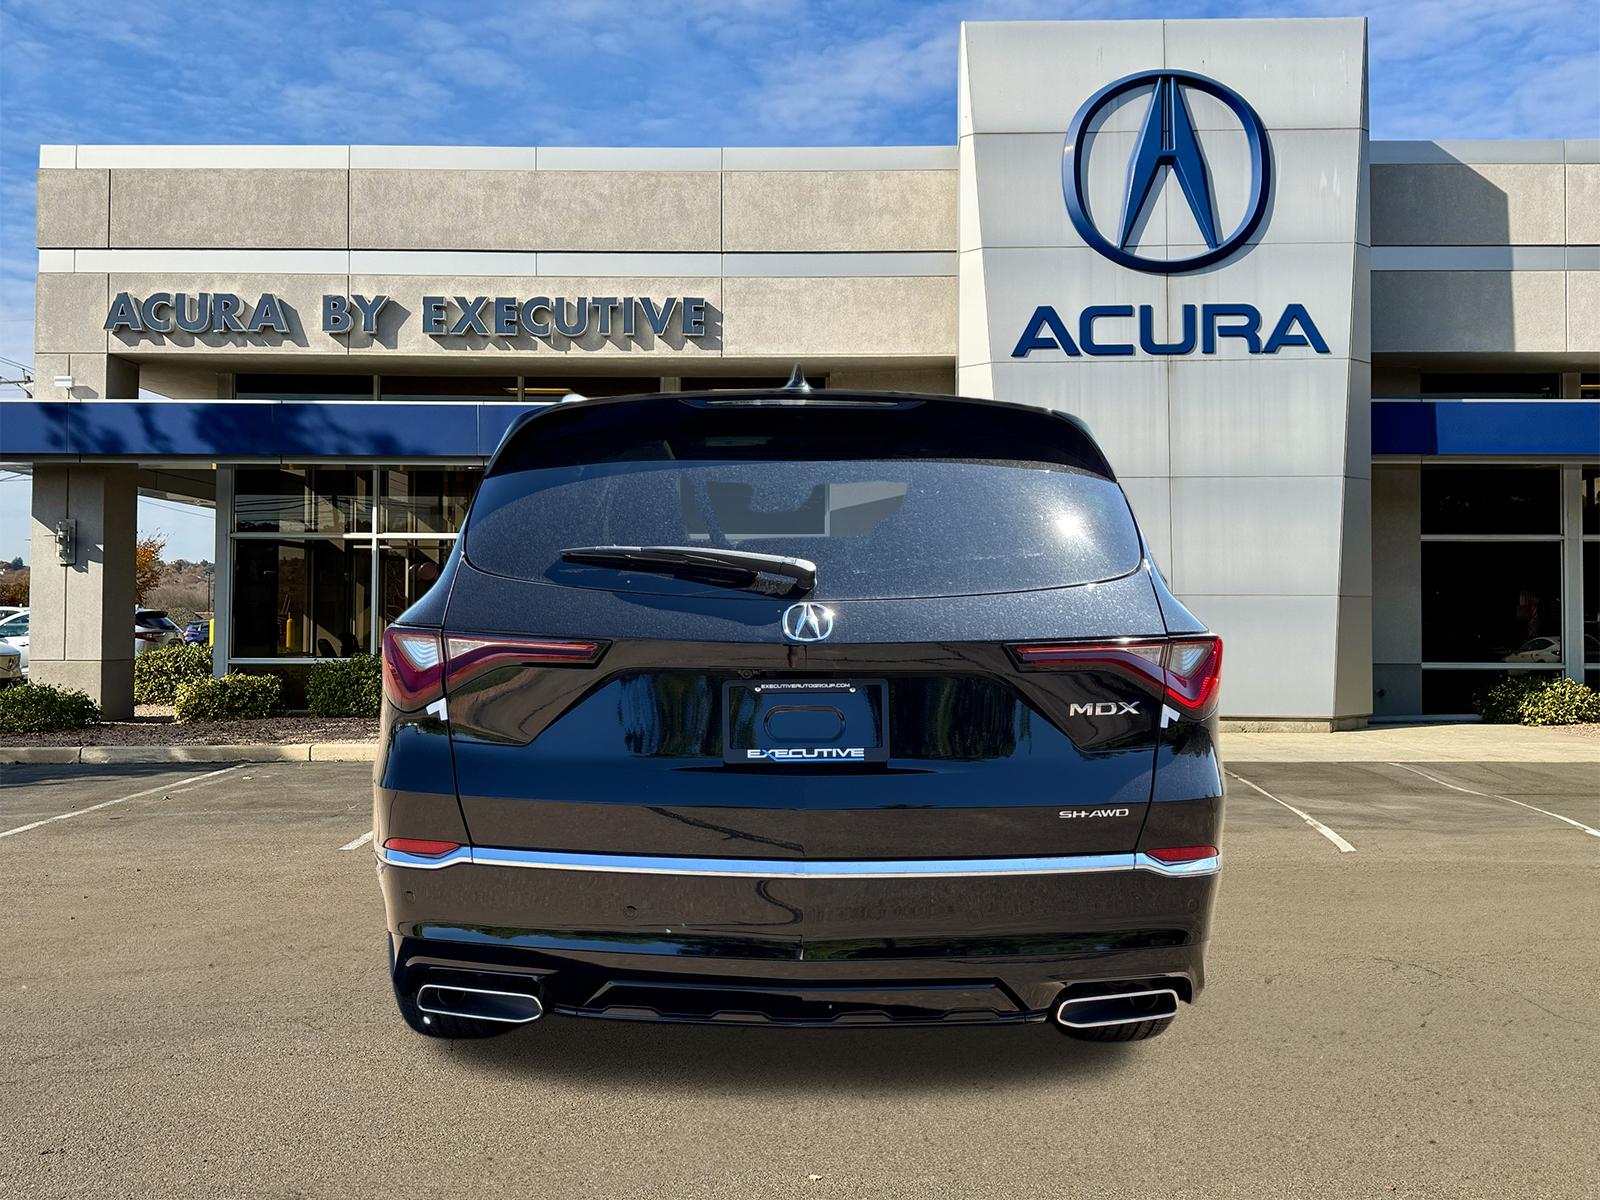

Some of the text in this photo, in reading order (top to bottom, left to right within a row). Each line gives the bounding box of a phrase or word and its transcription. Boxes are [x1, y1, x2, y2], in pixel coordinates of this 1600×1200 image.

[104, 291, 708, 338] ACURA BY EXECUTIVE
[1011, 303, 1332, 358] ACURA
[760, 682, 851, 690] EXECUTIVEAUTOGROUP.COM
[1069, 701, 1140, 717] MDX
[746, 747, 865, 762] EXECUTIVE
[1058, 808, 1130, 819] SH-AWD
